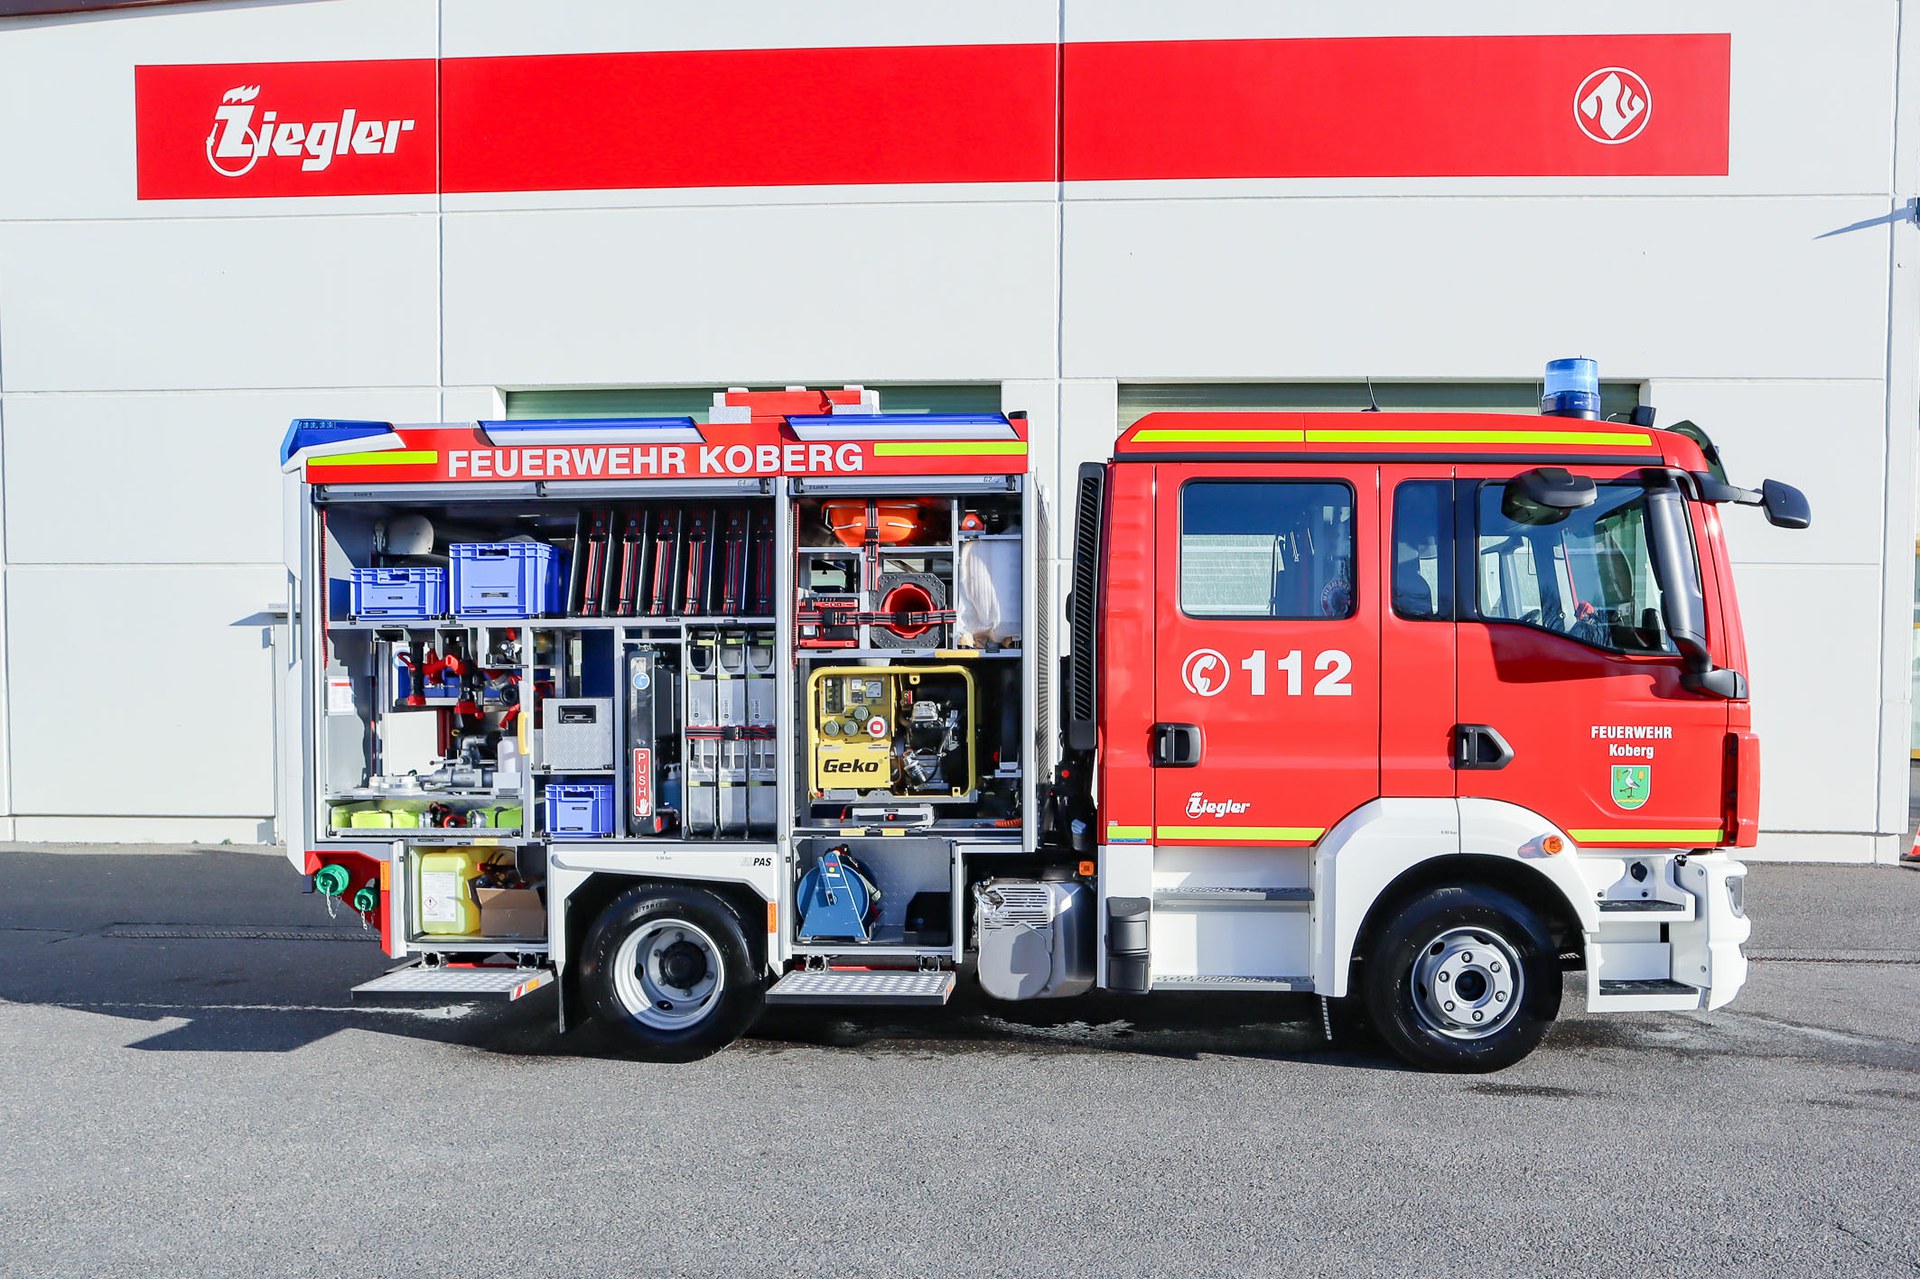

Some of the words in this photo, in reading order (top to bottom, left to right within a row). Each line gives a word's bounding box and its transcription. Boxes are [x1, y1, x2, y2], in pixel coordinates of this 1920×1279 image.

[206, 102, 416, 175] Ziegler
[448, 446, 686, 478] FEUERWEHR
[699, 443, 864, 474] KOBERG
[1240, 649, 1353, 696] 112
[1590, 725, 1673, 740] FEUERWEHR
[823, 758, 880, 774] Geko
[1609, 743, 1655, 759] Koberg
[637, 752, 649, 797] PUSH
[1185, 793, 1251, 819] Ziegler
